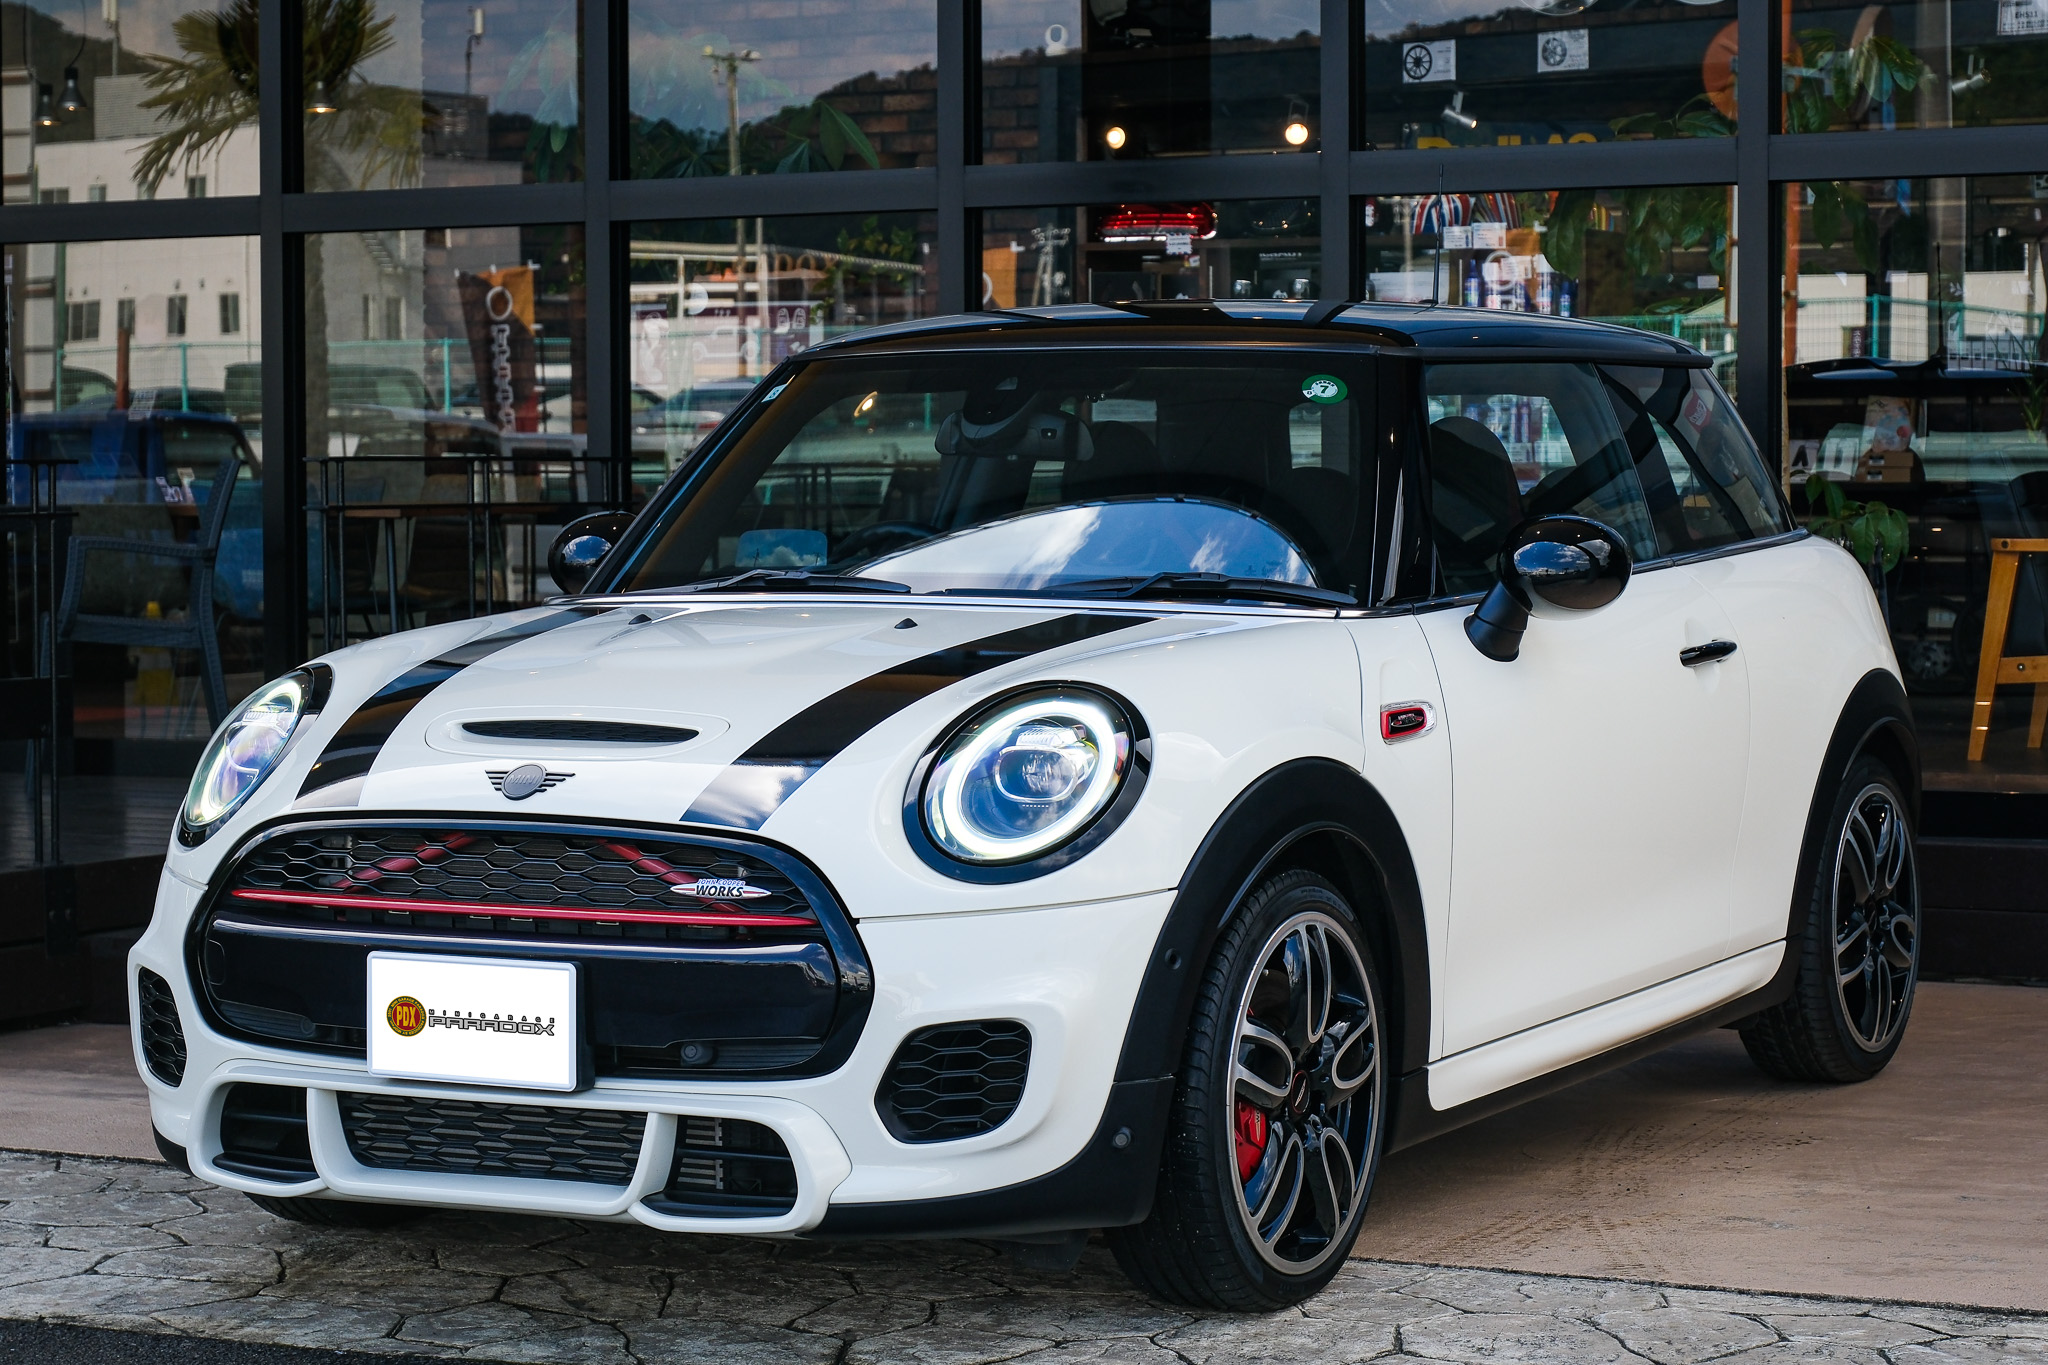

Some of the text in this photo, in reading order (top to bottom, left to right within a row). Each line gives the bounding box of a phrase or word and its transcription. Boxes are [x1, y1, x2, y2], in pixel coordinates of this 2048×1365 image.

[1320, 385, 1329, 394] 7
[508, 774, 539, 785] MINI
[696, 885, 744, 898] WORKS
[396, 1005, 416, 1027] PDX
[428, 1016, 555, 1036] PARADOX
